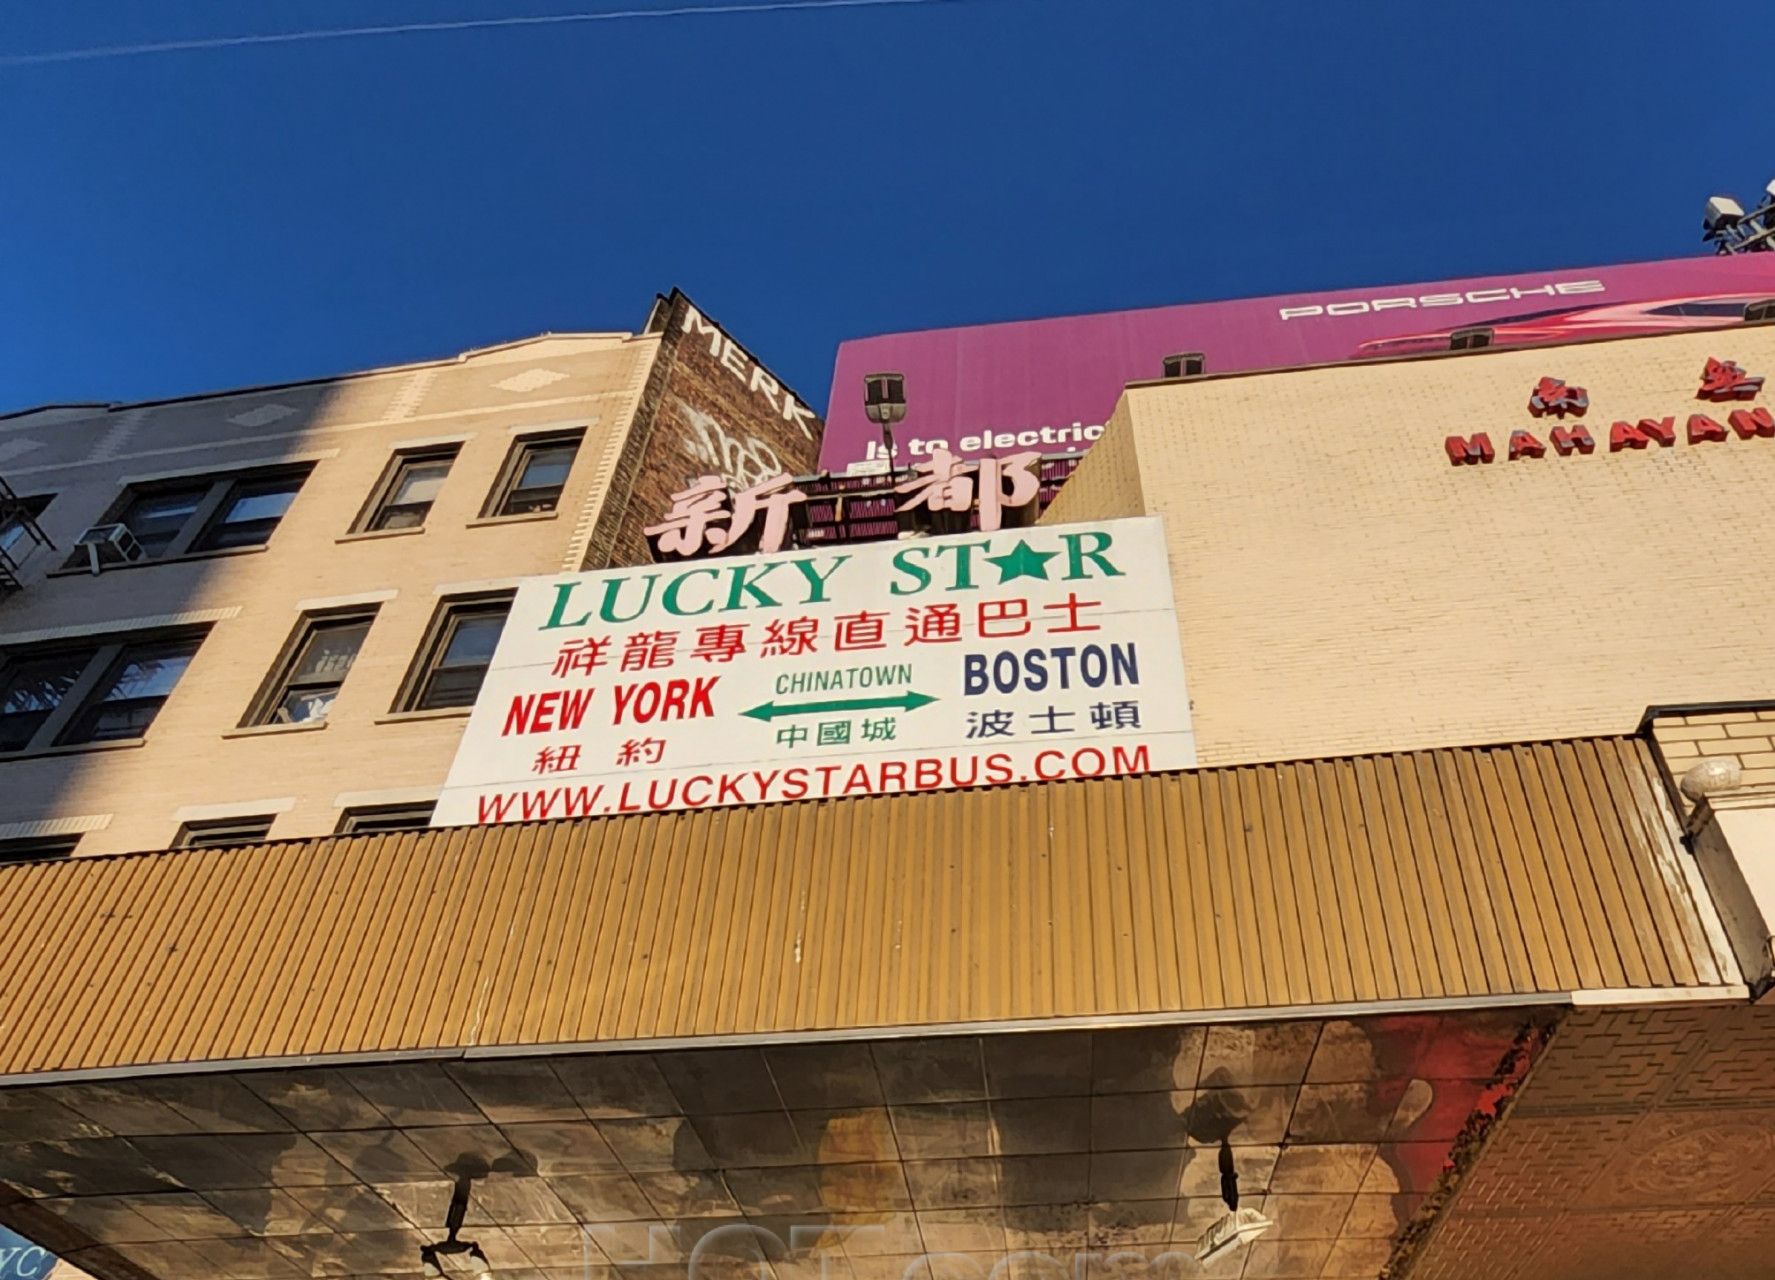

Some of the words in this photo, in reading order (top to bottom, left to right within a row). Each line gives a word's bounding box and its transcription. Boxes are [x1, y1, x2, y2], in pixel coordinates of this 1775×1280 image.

[1279, 279, 1606, 320] PORSCHE
[538, 554, 853, 631] LUCKY
[551, 592, 1102, 679] 祥龍專線直通巴士
[775, 663, 913, 695] CHINATOWN
[963, 641, 1140, 696] BOSTON
[501, 688, 595, 737] NEW
[611, 675, 722, 726] YORK
[966, 700, 1142, 739] 波士頓
[531, 736, 667, 775] 紐約
[775, 716, 897, 749] 中國城
[476, 744, 1151, 825] WWW.LUCKYSTARBUS.COM
